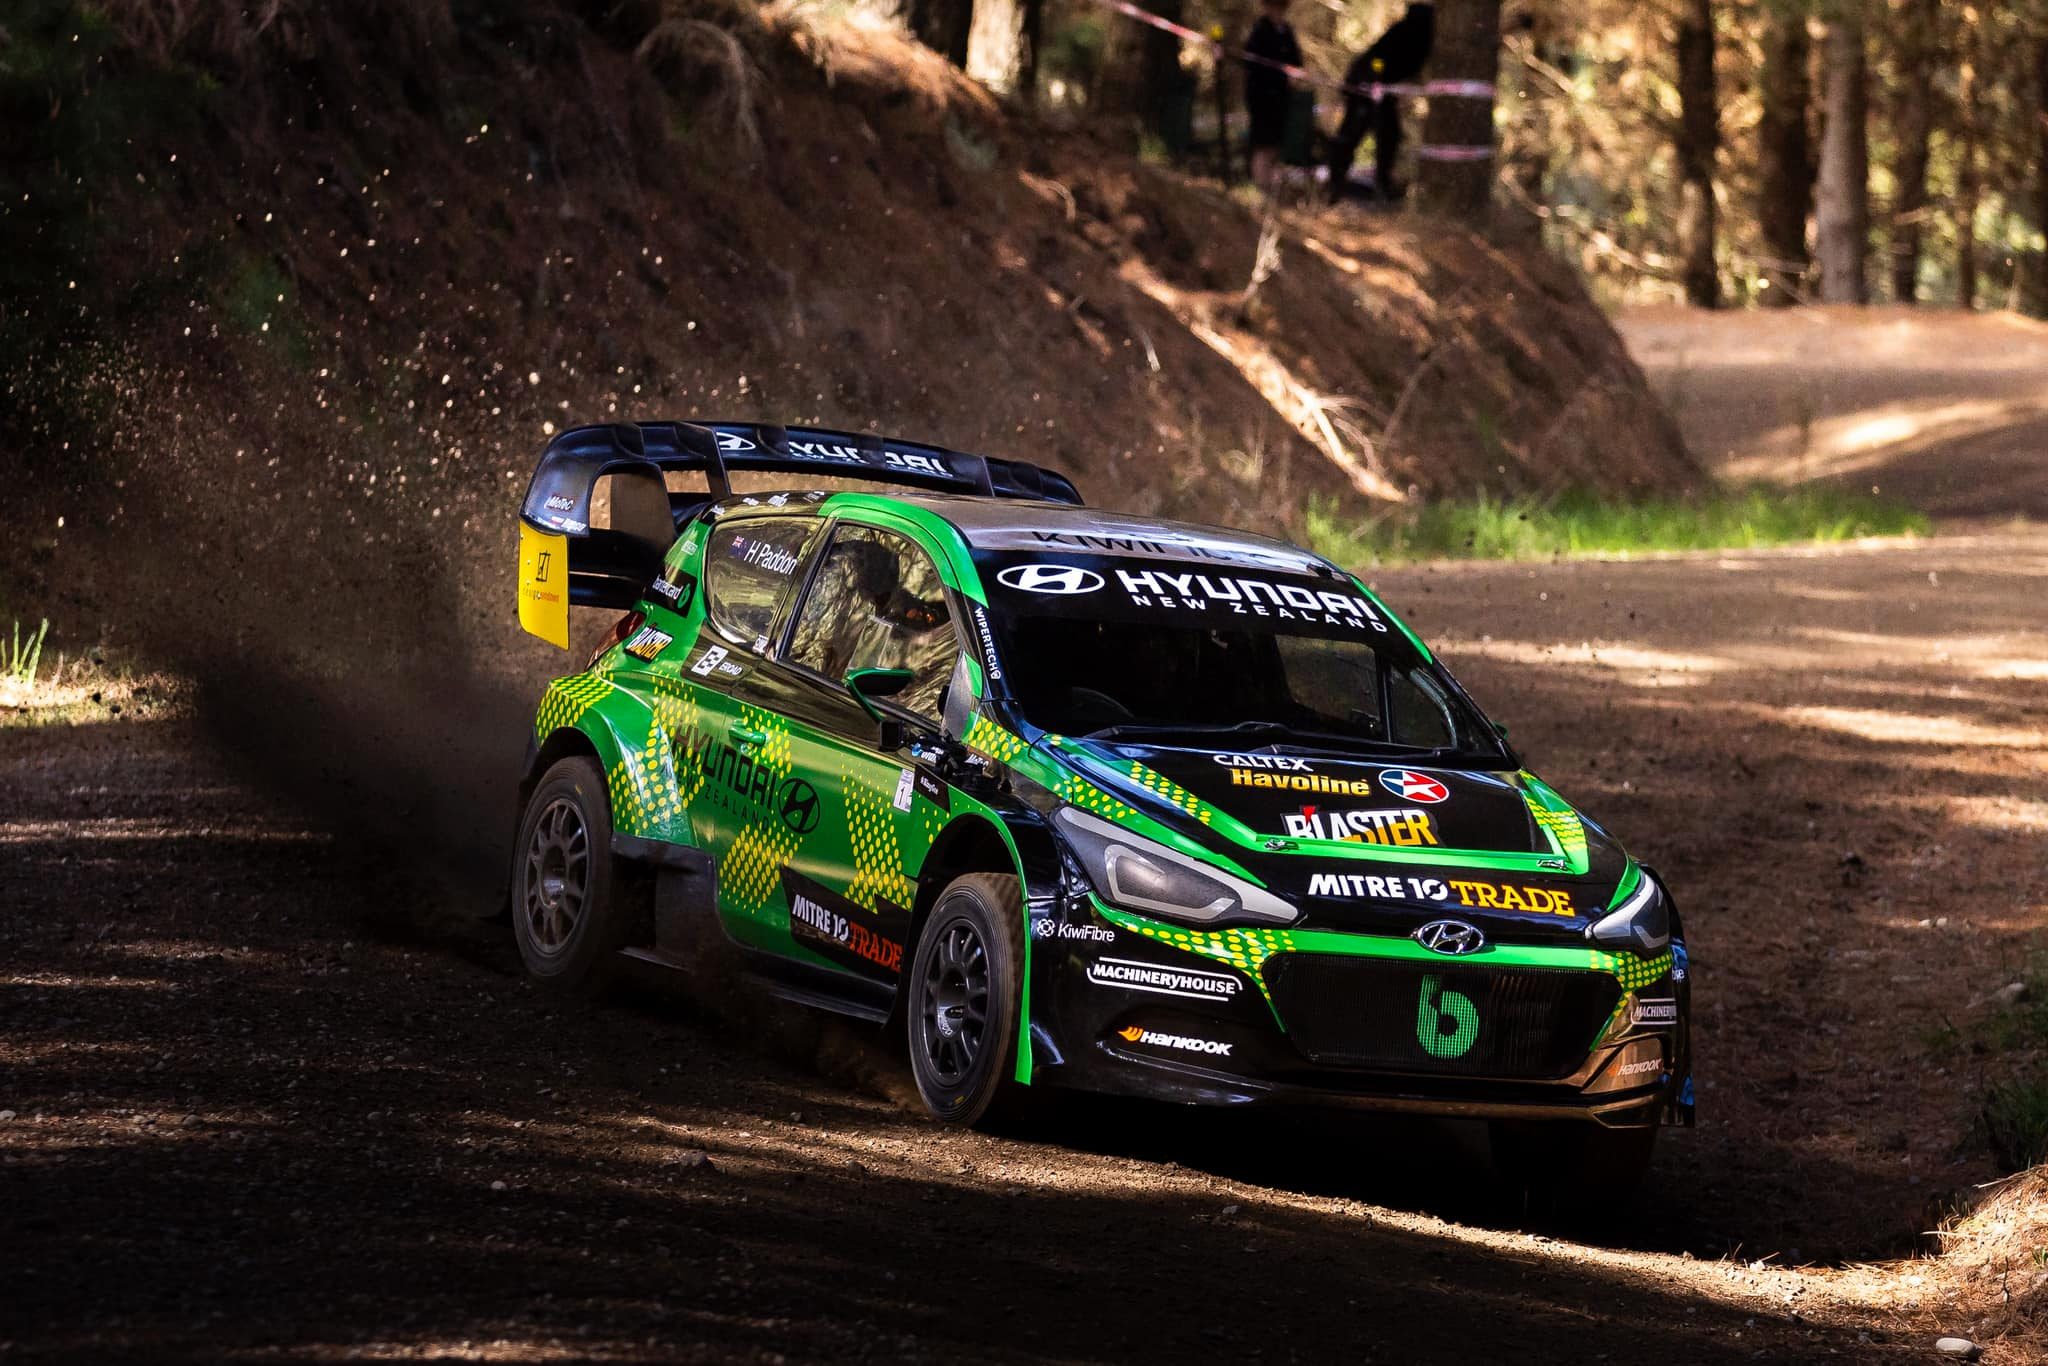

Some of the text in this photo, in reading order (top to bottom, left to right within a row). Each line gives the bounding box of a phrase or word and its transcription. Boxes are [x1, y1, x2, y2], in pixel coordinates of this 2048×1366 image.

[743, 539, 798, 576] H Paddon
[1114, 569, 1380, 621] HYUNDAI
[1131, 594, 1388, 633] NEW ZEALAND
[974, 606, 999, 672] WIPERTECH
[719, 661, 743, 676] EROAD
[671, 722, 779, 811] HYUNDAI
[1213, 754, 1314, 773] CALTEX
[1229, 768, 1371, 796] Havoline
[704, 783, 770, 832] ZEALAND
[1285, 806, 1439, 846] BLASTER
[1307, 873, 1576, 918] MITRE 10 TRADE
[792, 894, 904, 974] MITRE 10 TRADE
[1057, 923, 1116, 943] KiwiFibre
[1092, 963, 1236, 995] MACHINERYHOUSE
